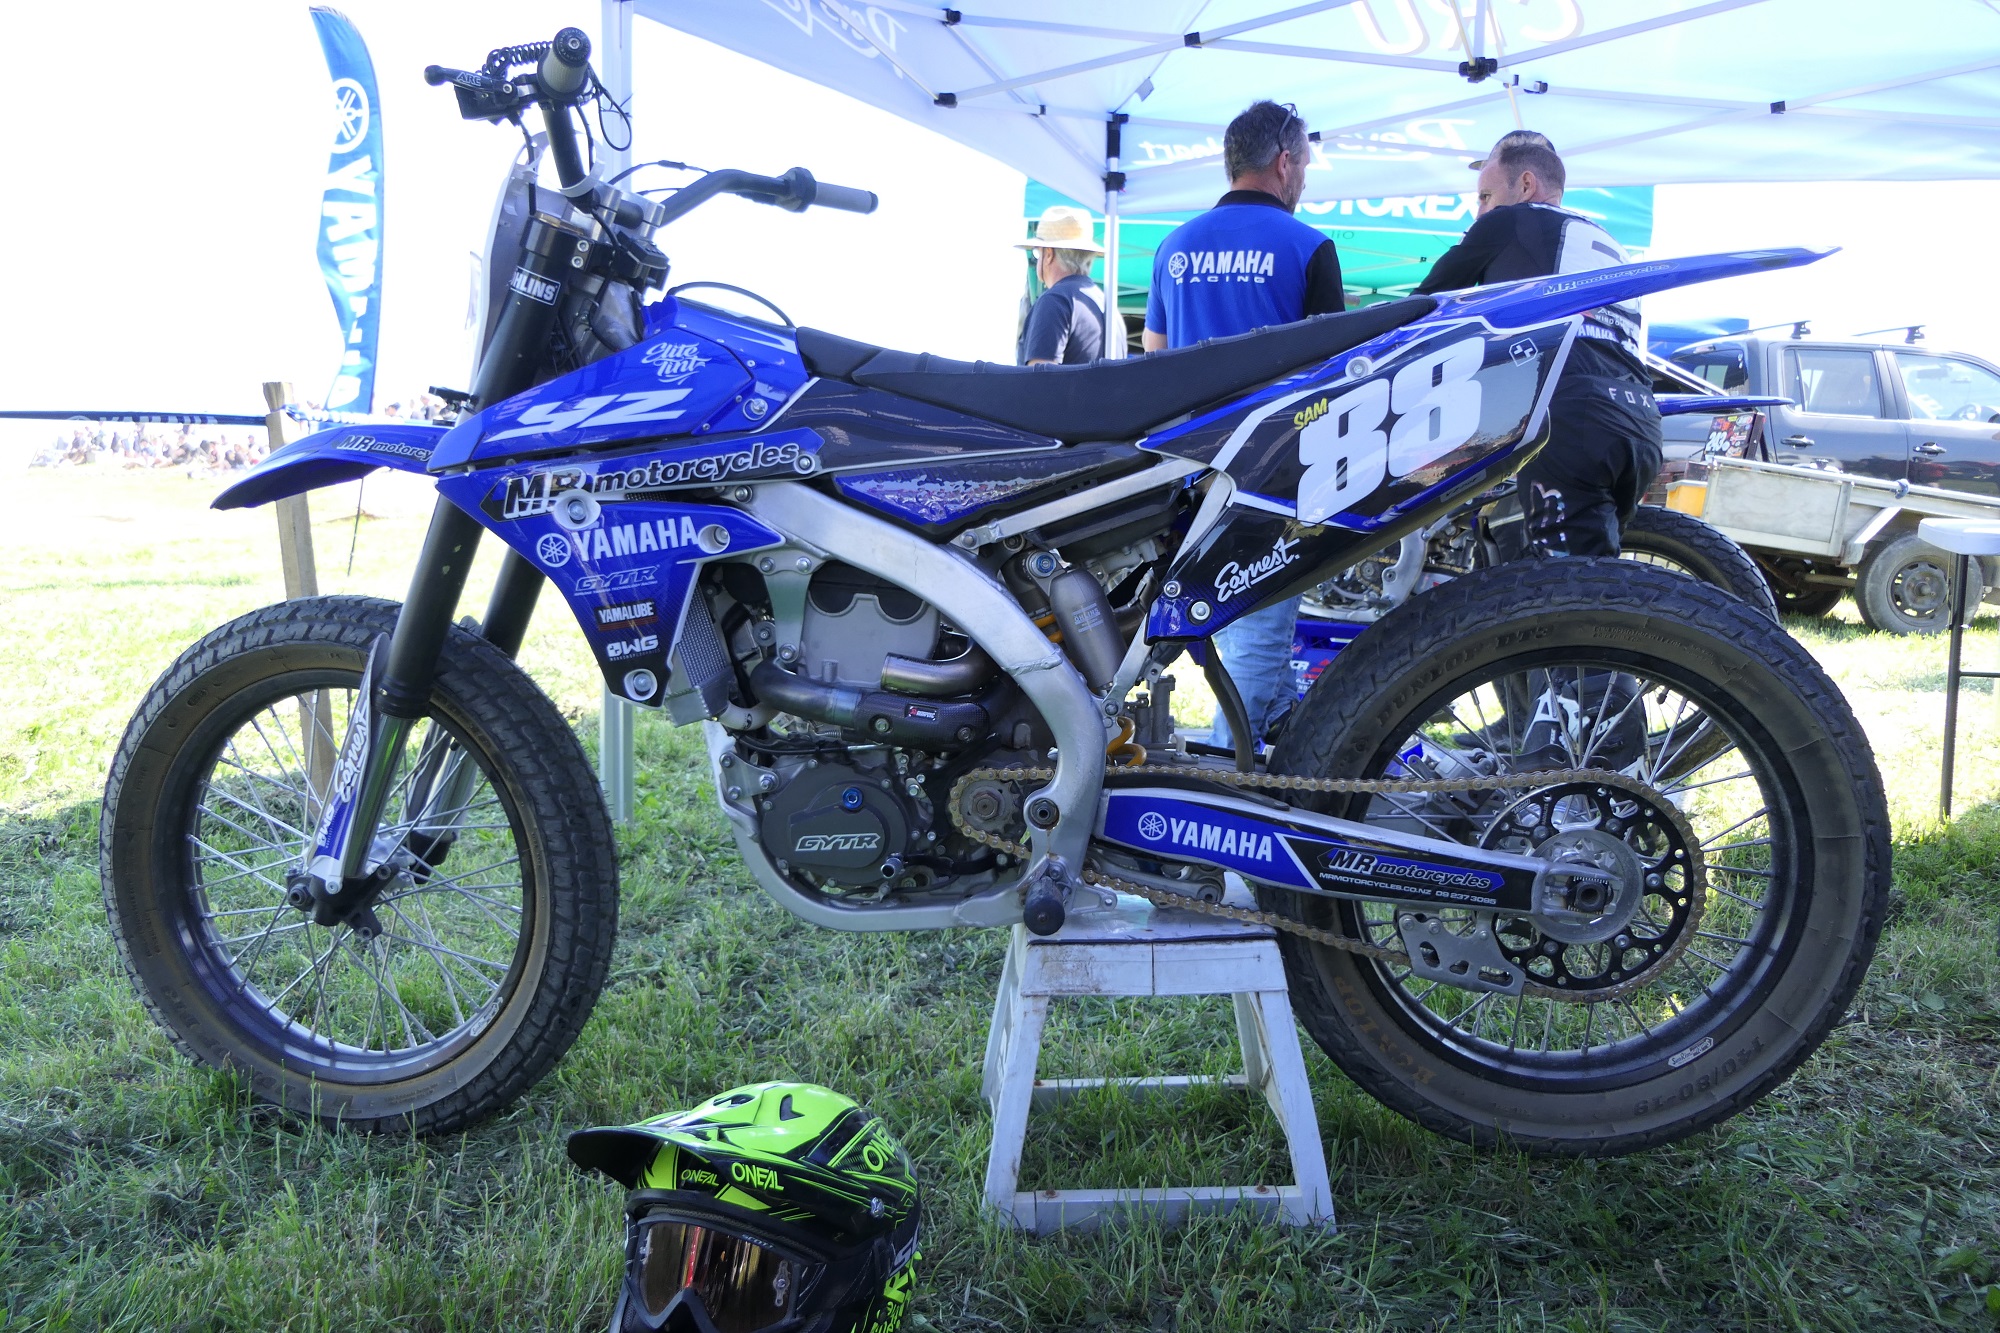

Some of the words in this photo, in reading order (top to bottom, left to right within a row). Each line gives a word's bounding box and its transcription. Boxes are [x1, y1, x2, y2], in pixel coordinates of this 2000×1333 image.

[456, 72, 482, 86] ARC
[1190, 250, 1274, 276] YAMAHA
[1577, 263, 1670, 287] motorcycles
[1176, 275, 1265, 285] RACING
[1578, 323, 1613, 341] AMAHA
[641, 342, 700, 363] Elite
[653, 356, 711, 381] Tint
[482, 388, 694, 444] YZ
[1294, 397, 1329, 431] SAM
[337, 434, 375, 452] MR
[1297, 336, 1486, 528] 88
[503, 467, 587, 519] MR
[594, 442, 801, 494] motorcycles
[572, 515, 701, 562] YAMAHA
[598, 602, 655, 624] YAMALUBE
[795, 833, 881, 852] GYTR
[1170, 817, 1273, 862] YAMAHA
[1328, 848, 1377, 875] MR
[1375, 862, 1491, 889] motorcycles
[1319, 872, 1432, 896] MRMOTORCYCLES.CO.NZ
[1435, 890, 1450, 899] 09
[1450, 892, 1471, 902] 237
